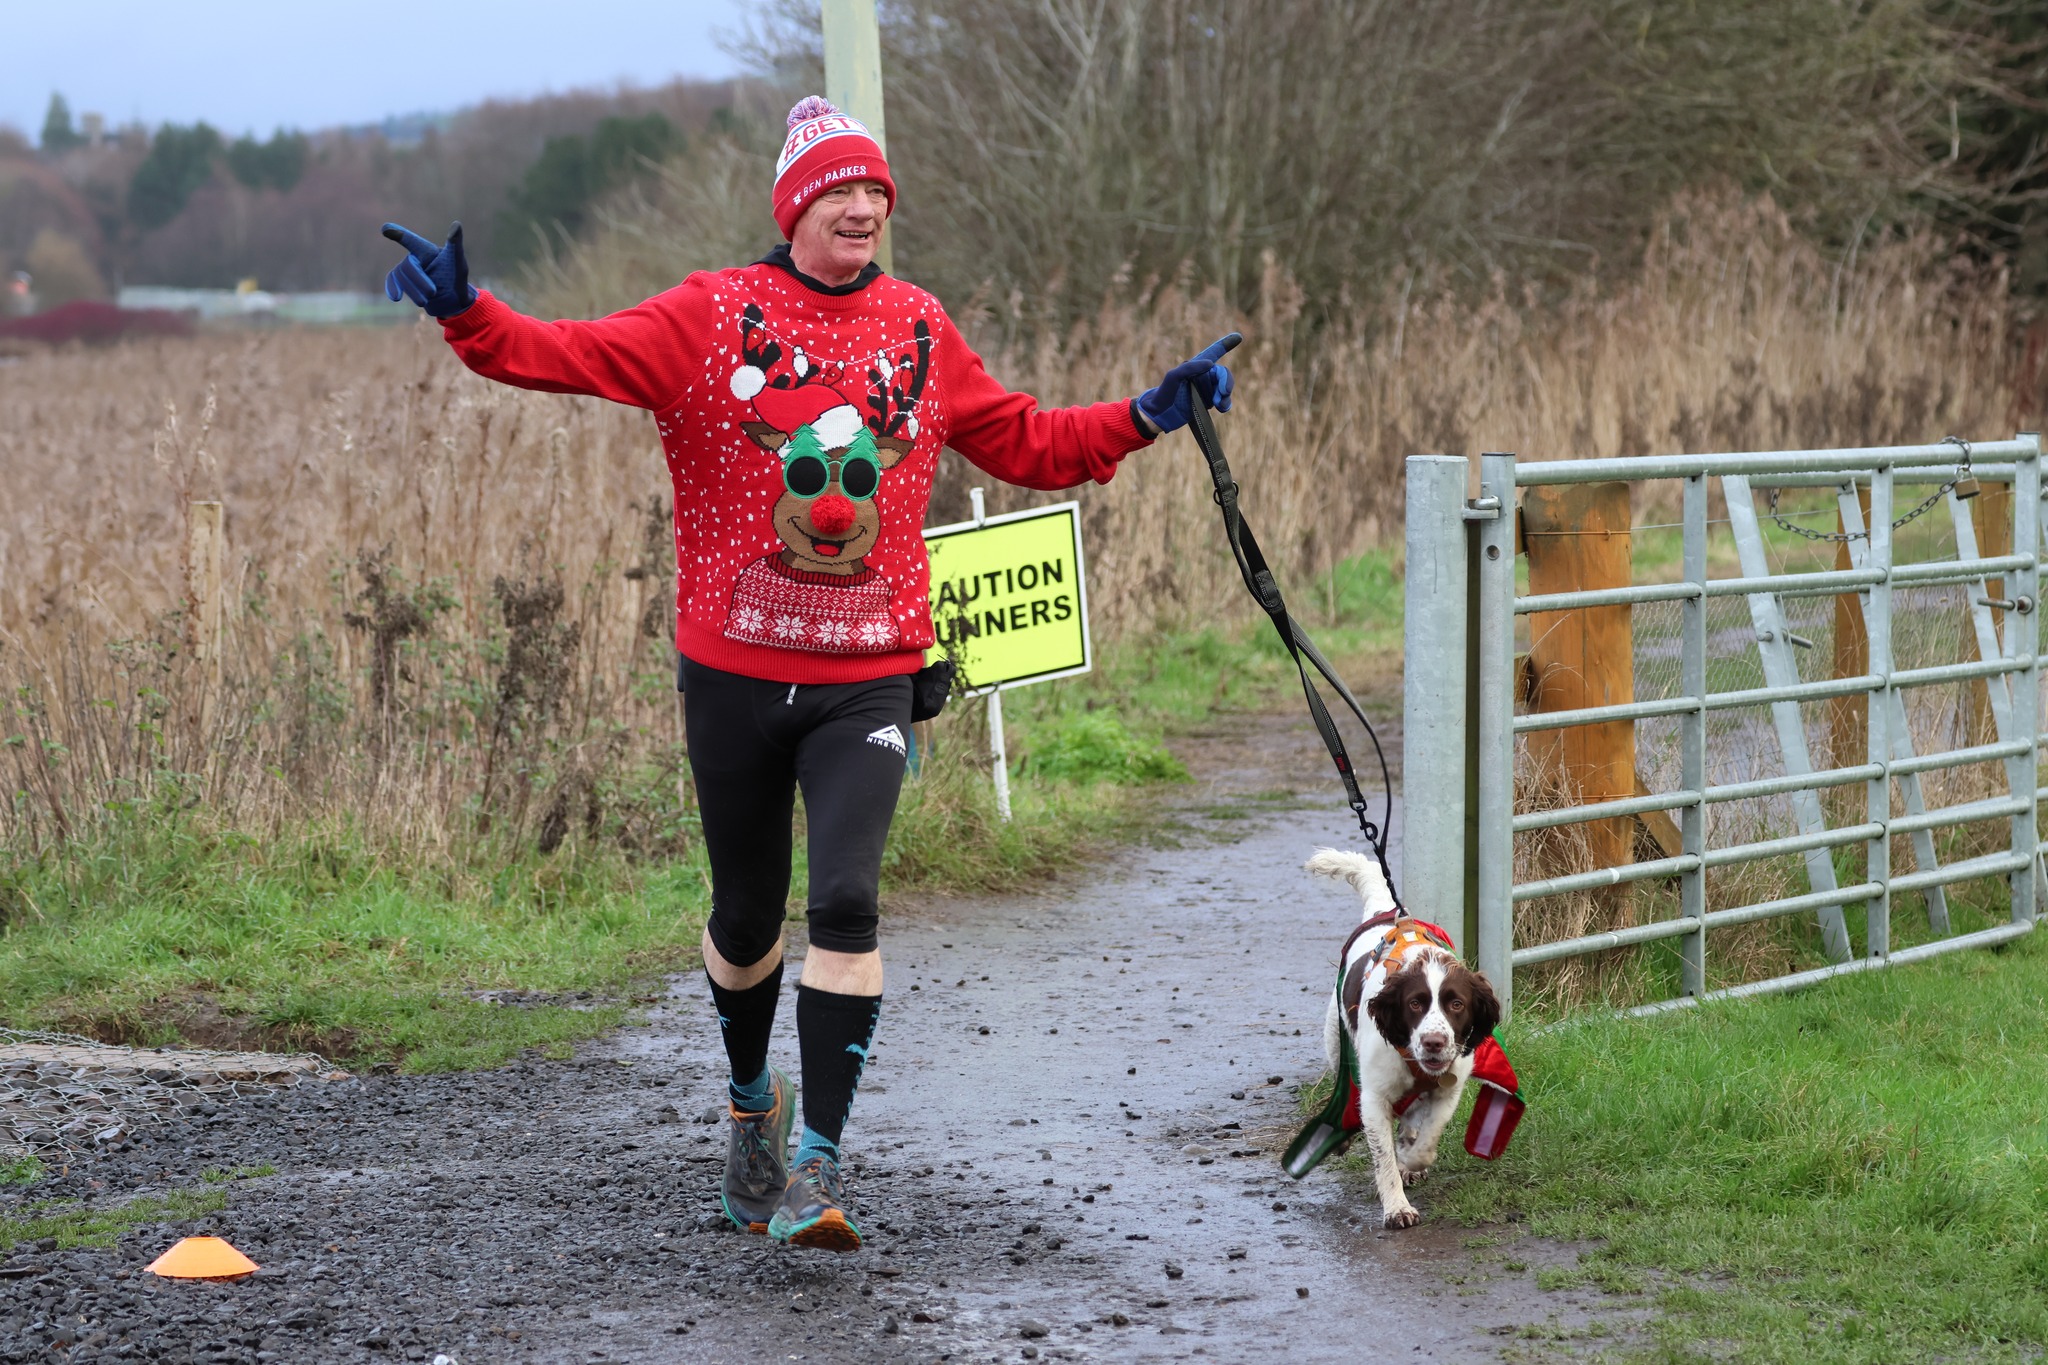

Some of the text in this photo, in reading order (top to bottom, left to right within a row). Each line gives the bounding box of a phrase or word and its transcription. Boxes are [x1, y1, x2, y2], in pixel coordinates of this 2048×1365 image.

[803, 165, 867, 197] BEN PARKES
[929, 558, 1063, 614] AUTION
[935, 595, 1072, 648] UNNERS
[866, 736, 889, 748] NIKE
